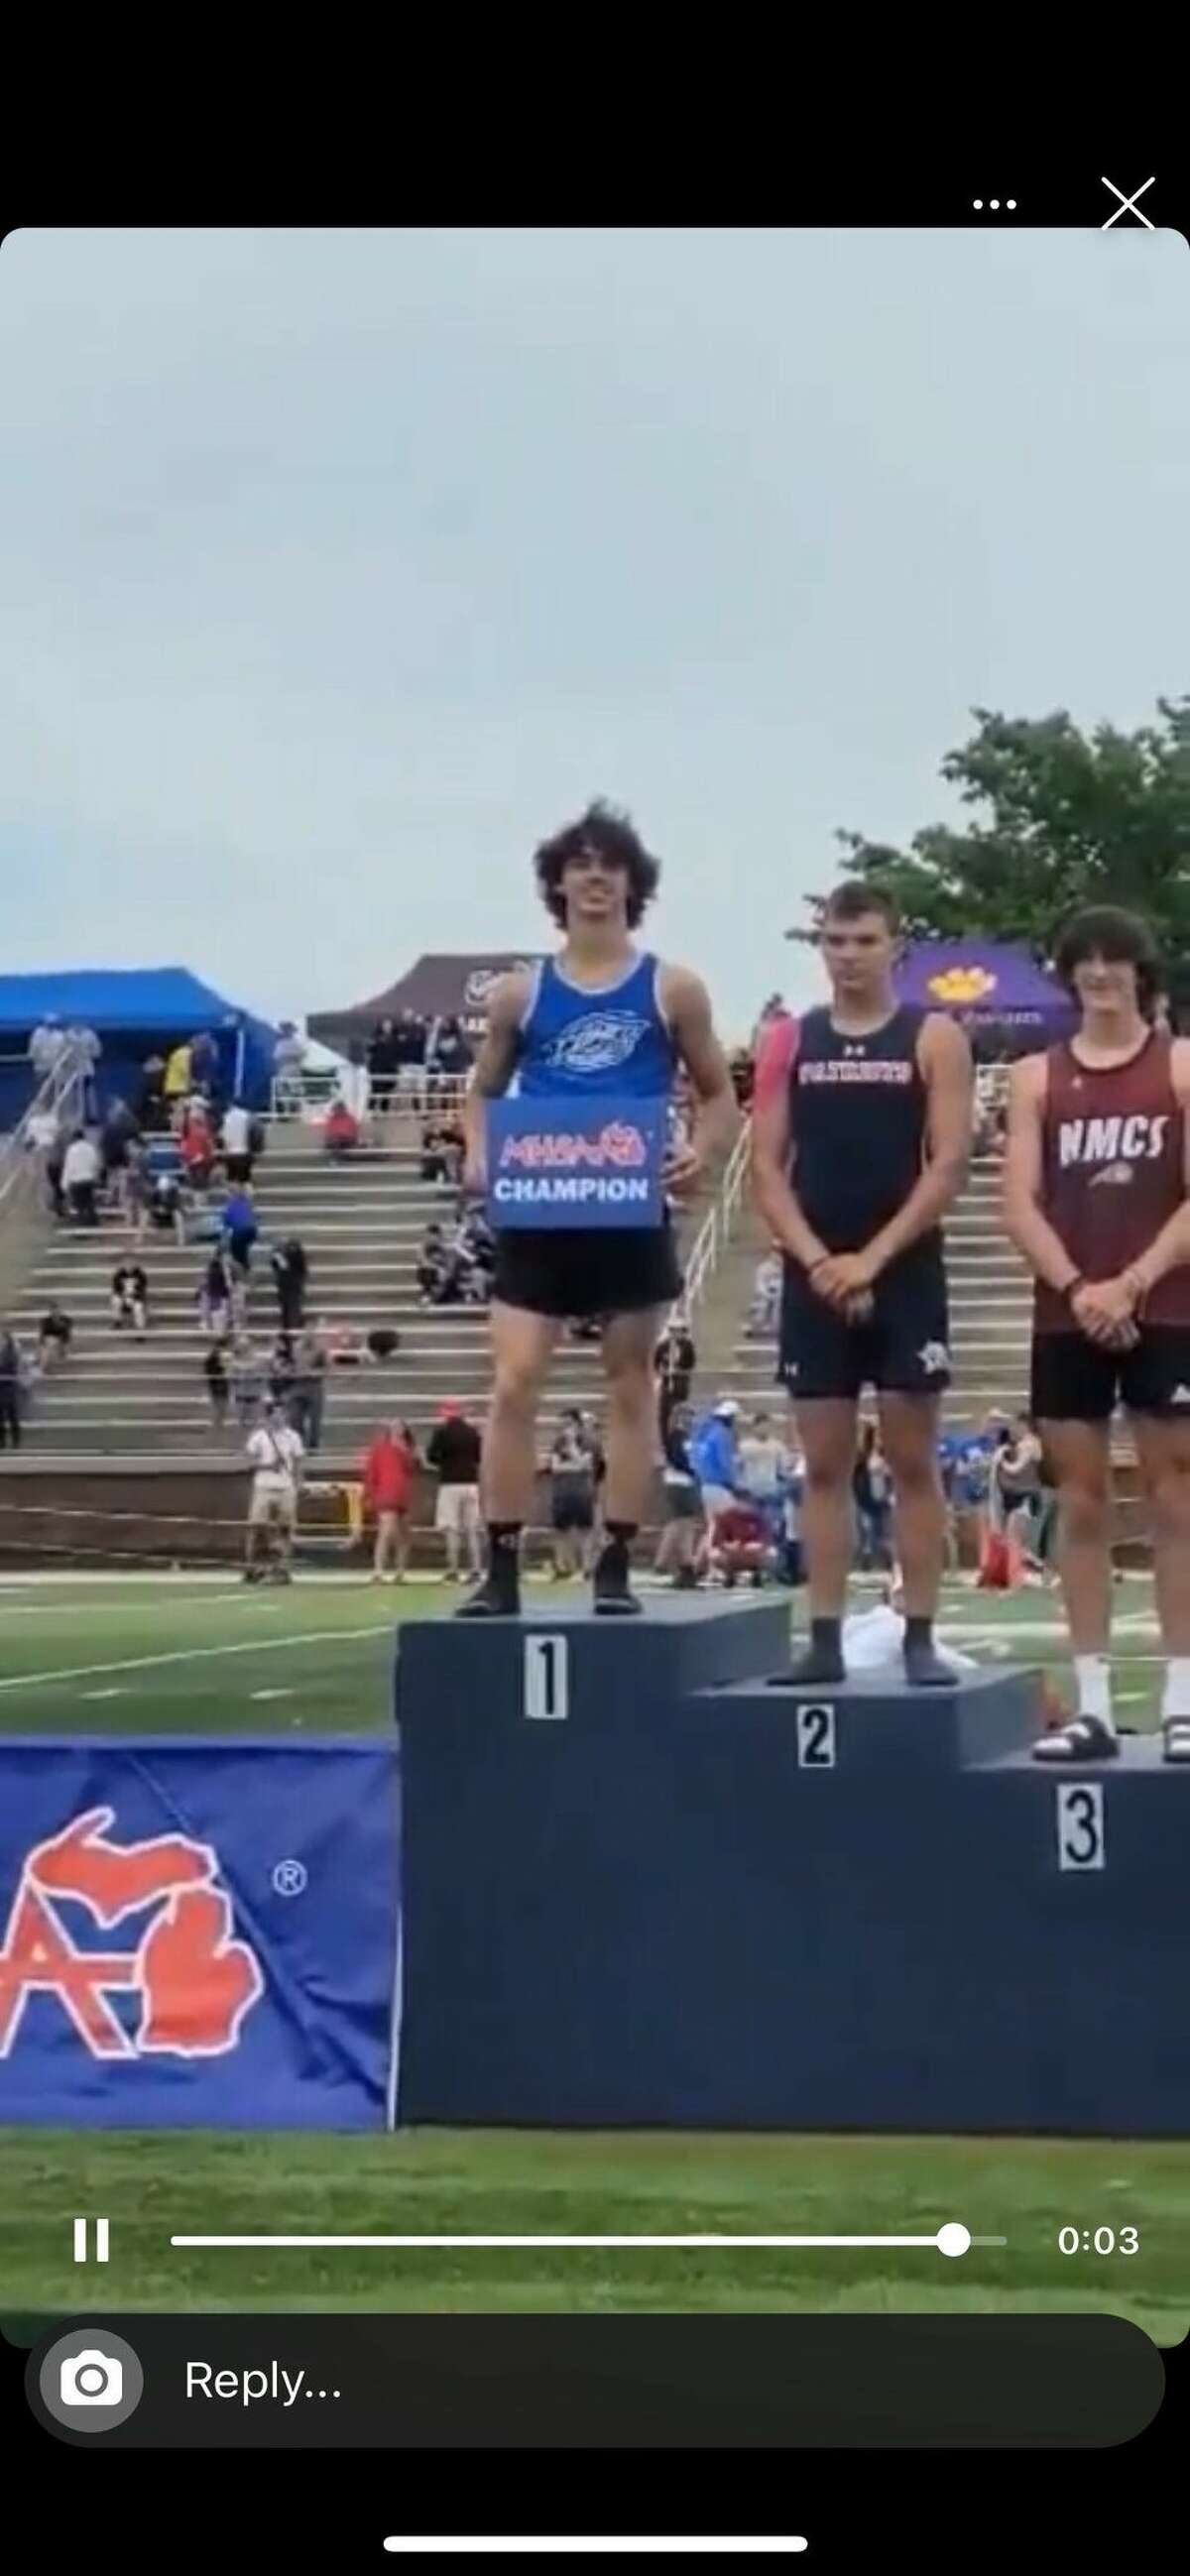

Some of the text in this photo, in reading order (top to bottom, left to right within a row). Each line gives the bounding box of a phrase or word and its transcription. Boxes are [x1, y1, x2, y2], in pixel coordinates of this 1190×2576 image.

[1059, 1115, 1169, 1168] NMCS
[494, 1177, 649, 1202] CHAMPION
[537, 1641, 554, 1715] 1
[804, 1708, 829, 1764] 2
[1066, 1789, 1097, 1863] 3
